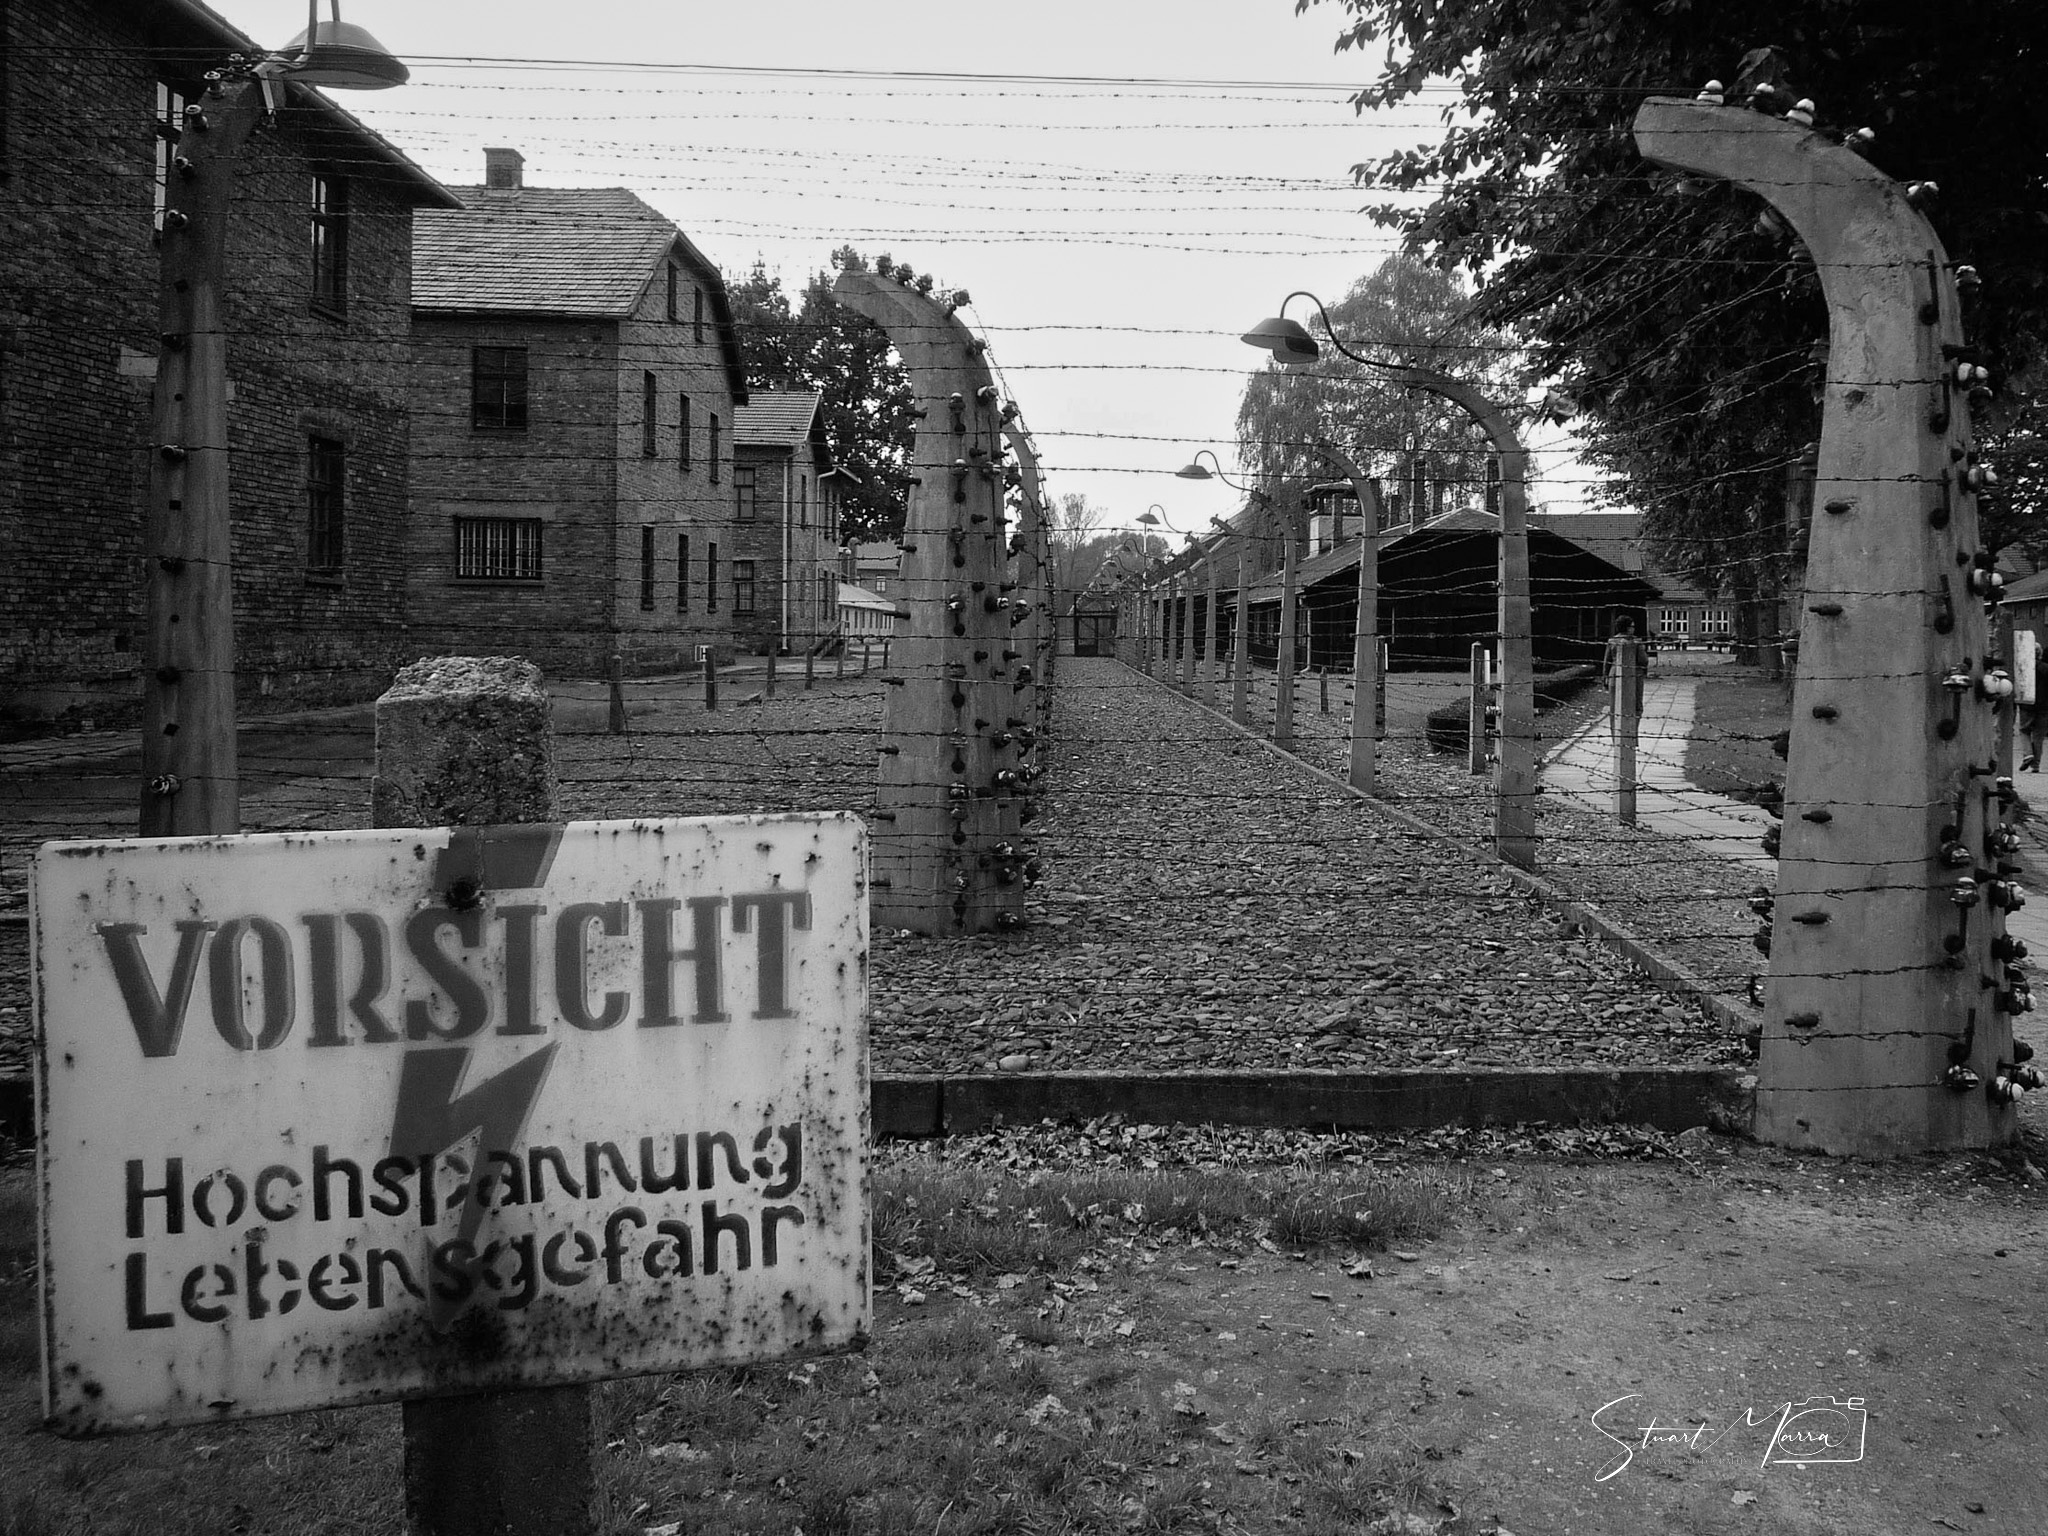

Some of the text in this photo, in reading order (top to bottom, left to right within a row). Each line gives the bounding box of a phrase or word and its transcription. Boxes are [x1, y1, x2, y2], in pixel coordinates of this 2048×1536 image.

[94, 890, 812, 1057] VORSICHT
[126, 1122, 802, 1239] Hochspannung
[126, 1200, 804, 1331] Lebensgefahr
